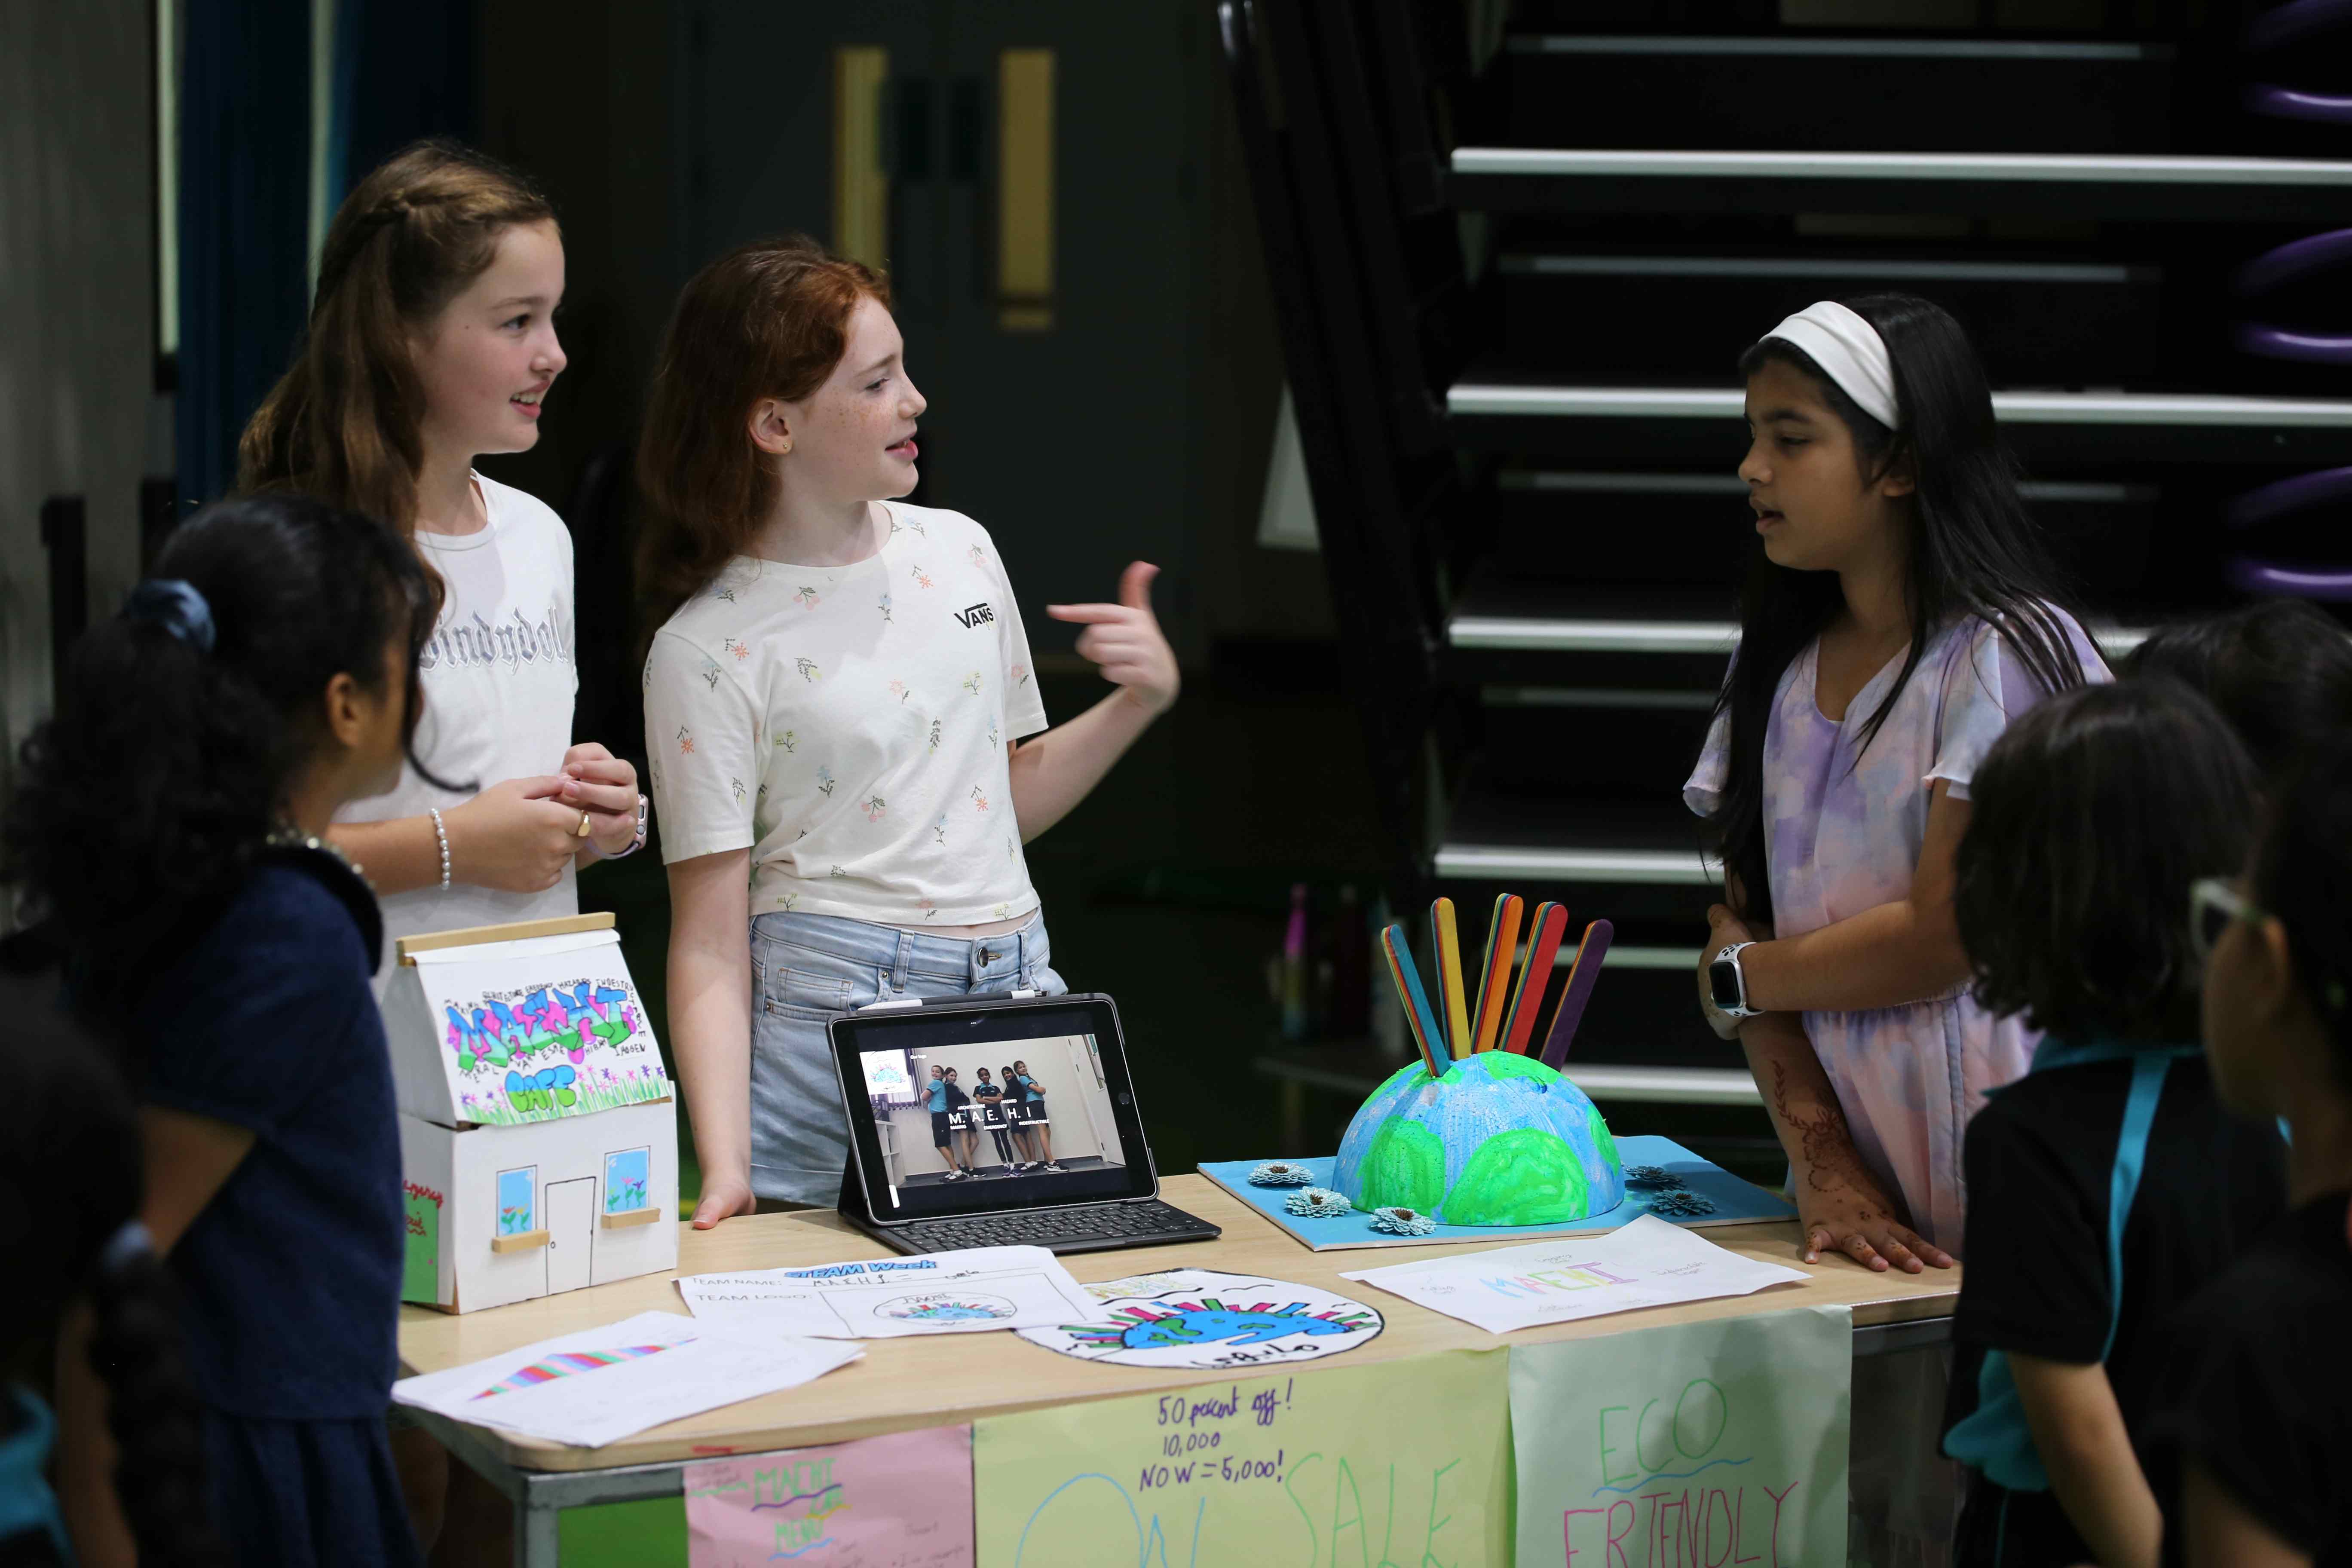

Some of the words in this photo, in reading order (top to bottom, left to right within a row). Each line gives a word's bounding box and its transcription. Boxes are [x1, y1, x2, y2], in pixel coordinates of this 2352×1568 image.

[954, 603, 994, 628] VANS
[784, 1264, 866, 1278] STEAM
[867, 1260, 937, 1272] Week
[1158, 1395, 1185, 1426] 50
[1163, 1432, 1221, 1458] 10,000
[1600, 1378, 1727, 1486] ECO
[1140, 1461, 1197, 1491] NOW
[1221, 1449, 1284, 1483] 5,000!
[1284, 1452, 1461, 1568] SALE
